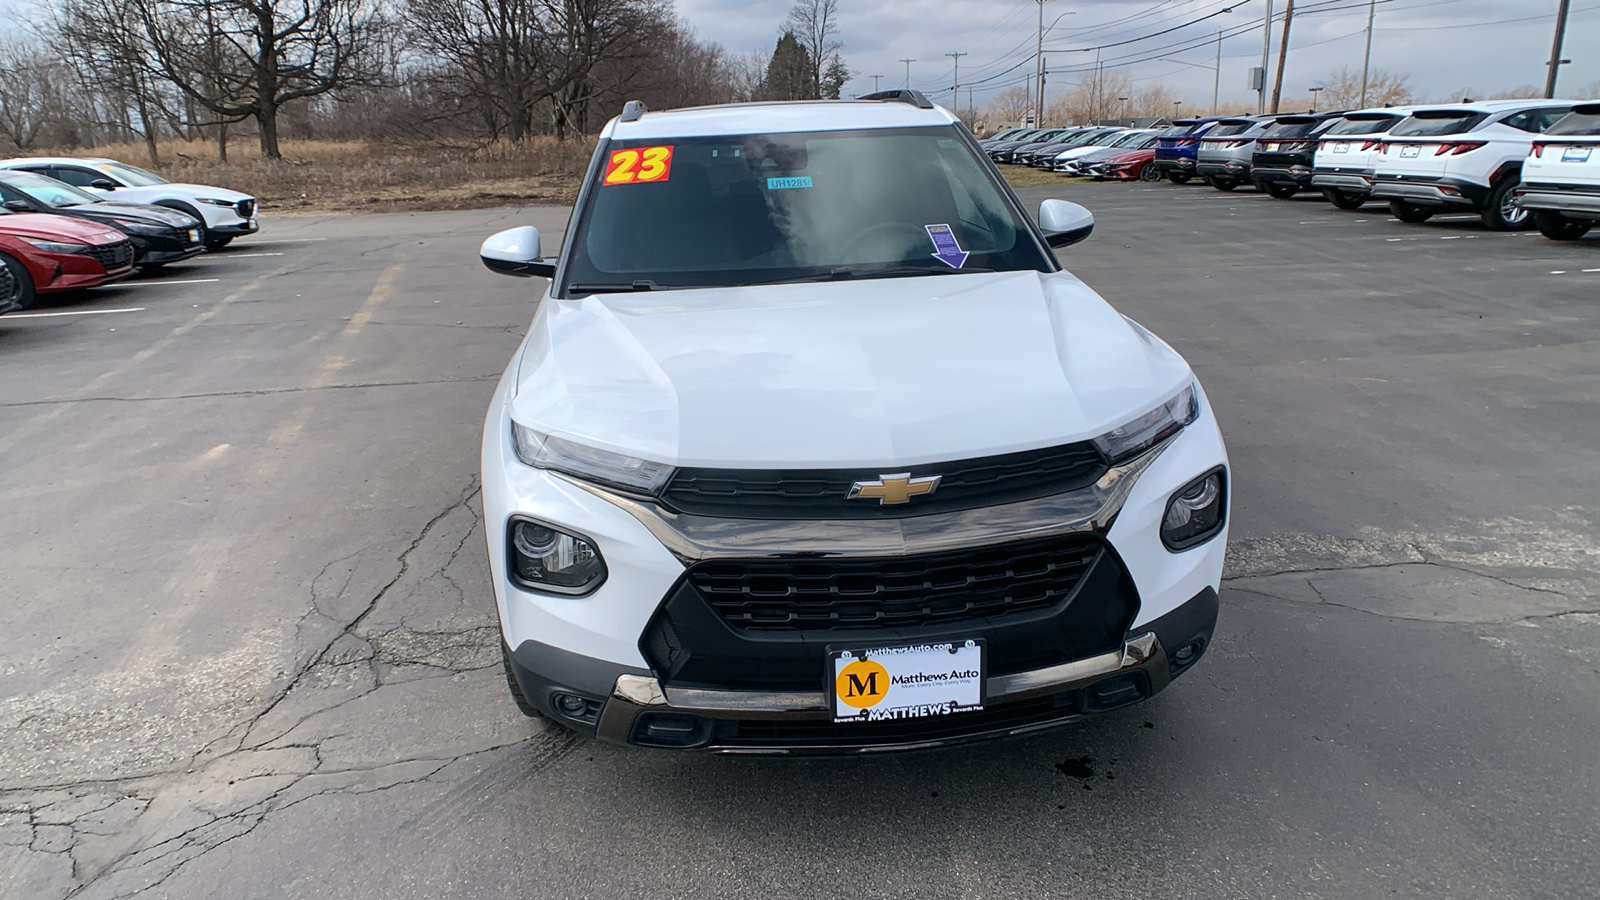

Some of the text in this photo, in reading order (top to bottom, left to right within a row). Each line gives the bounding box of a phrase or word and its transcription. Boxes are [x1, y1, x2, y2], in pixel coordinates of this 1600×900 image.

[606, 147, 671, 183] 23
[864, 643, 953, 657] MatthewsAuto.com
[845, 671, 880, 698] M
[891, 669, 979, 686] Matthews Auto
[867, 703, 951, 722] MATTHEWS
